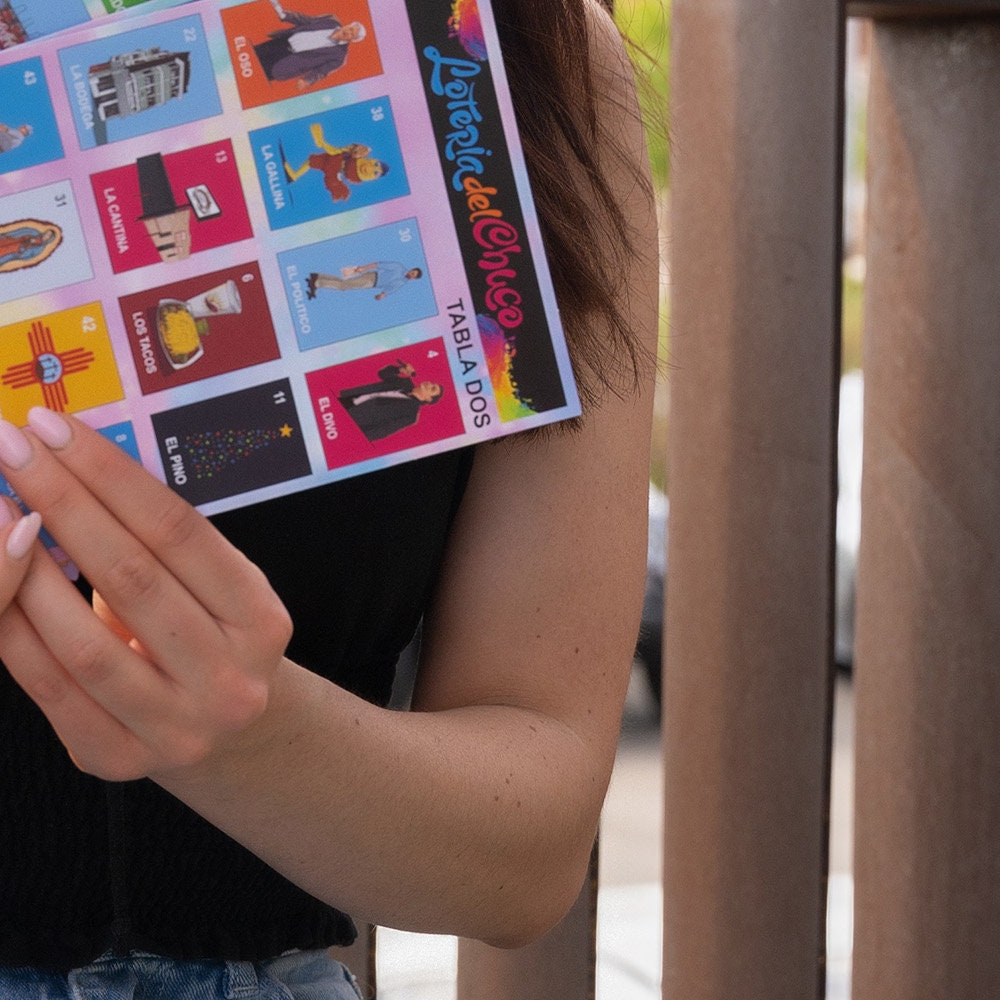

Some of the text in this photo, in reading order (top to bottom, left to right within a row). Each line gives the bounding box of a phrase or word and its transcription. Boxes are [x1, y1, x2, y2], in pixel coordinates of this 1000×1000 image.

[183, 27, 196, 42] 22
[233, 36, 254, 79] EL OSO
[23, 70, 37, 86] 43
[69, 64, 82, 82] LA
[370, 106, 384, 121] 38
[215, 150, 228, 163] 13
[260, 144, 286, 210] LA GALLINA
[54, 193, 67, 208] 31
[103, 187, 130, 254] LA CANTINA
[398, 227, 412, 243] 30
[287, 265, 299, 283] EL
[472, 217, 523, 328] Chuco
[81, 315, 97, 332] 42
[131, 311, 158, 374] LOS TACOS
[427, 350, 439, 359] 4
[447, 298, 491, 429] TABLA DOS
[273, 390, 286, 404] 11
[318, 396, 338, 440] EL DIVO
[164, 436, 188, 485] EL PINO
